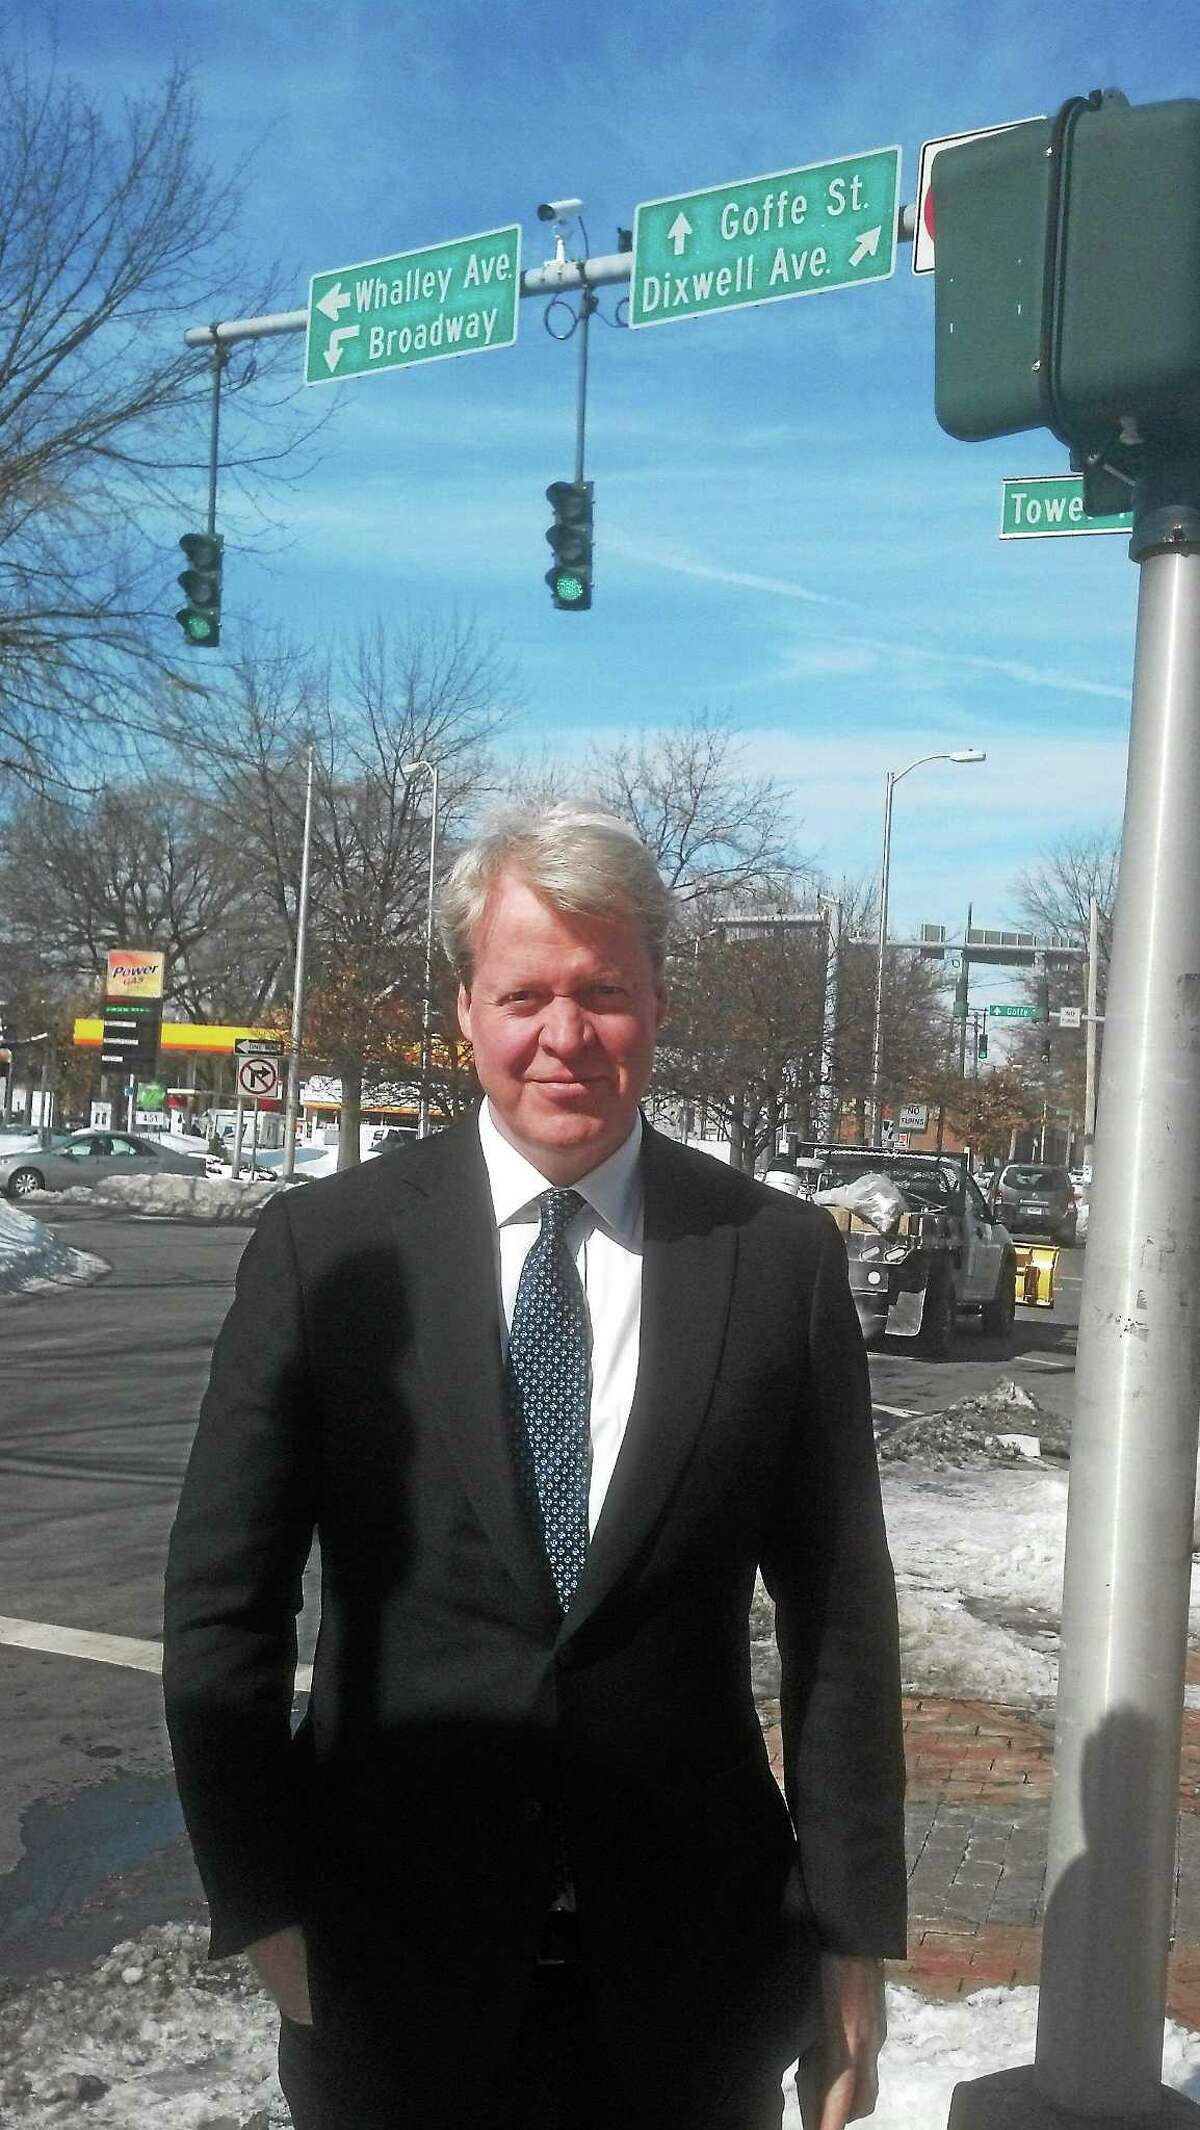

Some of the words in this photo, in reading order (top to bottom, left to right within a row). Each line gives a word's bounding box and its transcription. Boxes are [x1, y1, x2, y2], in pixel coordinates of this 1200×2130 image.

[720, 190, 808, 241] Goffe
[826, 174, 869, 217] St.
[355, 267, 453, 314] Whalley
[463, 253, 513, 289] Ave.
[642, 253, 754, 313] Dixwell
[769, 246, 831, 286] Ave.
[368, 307, 498, 361] Broadway
[1010, 492, 1095, 524] Towe
[113, 964, 159, 978] Power
[907, 1105, 920, 1116] NO
